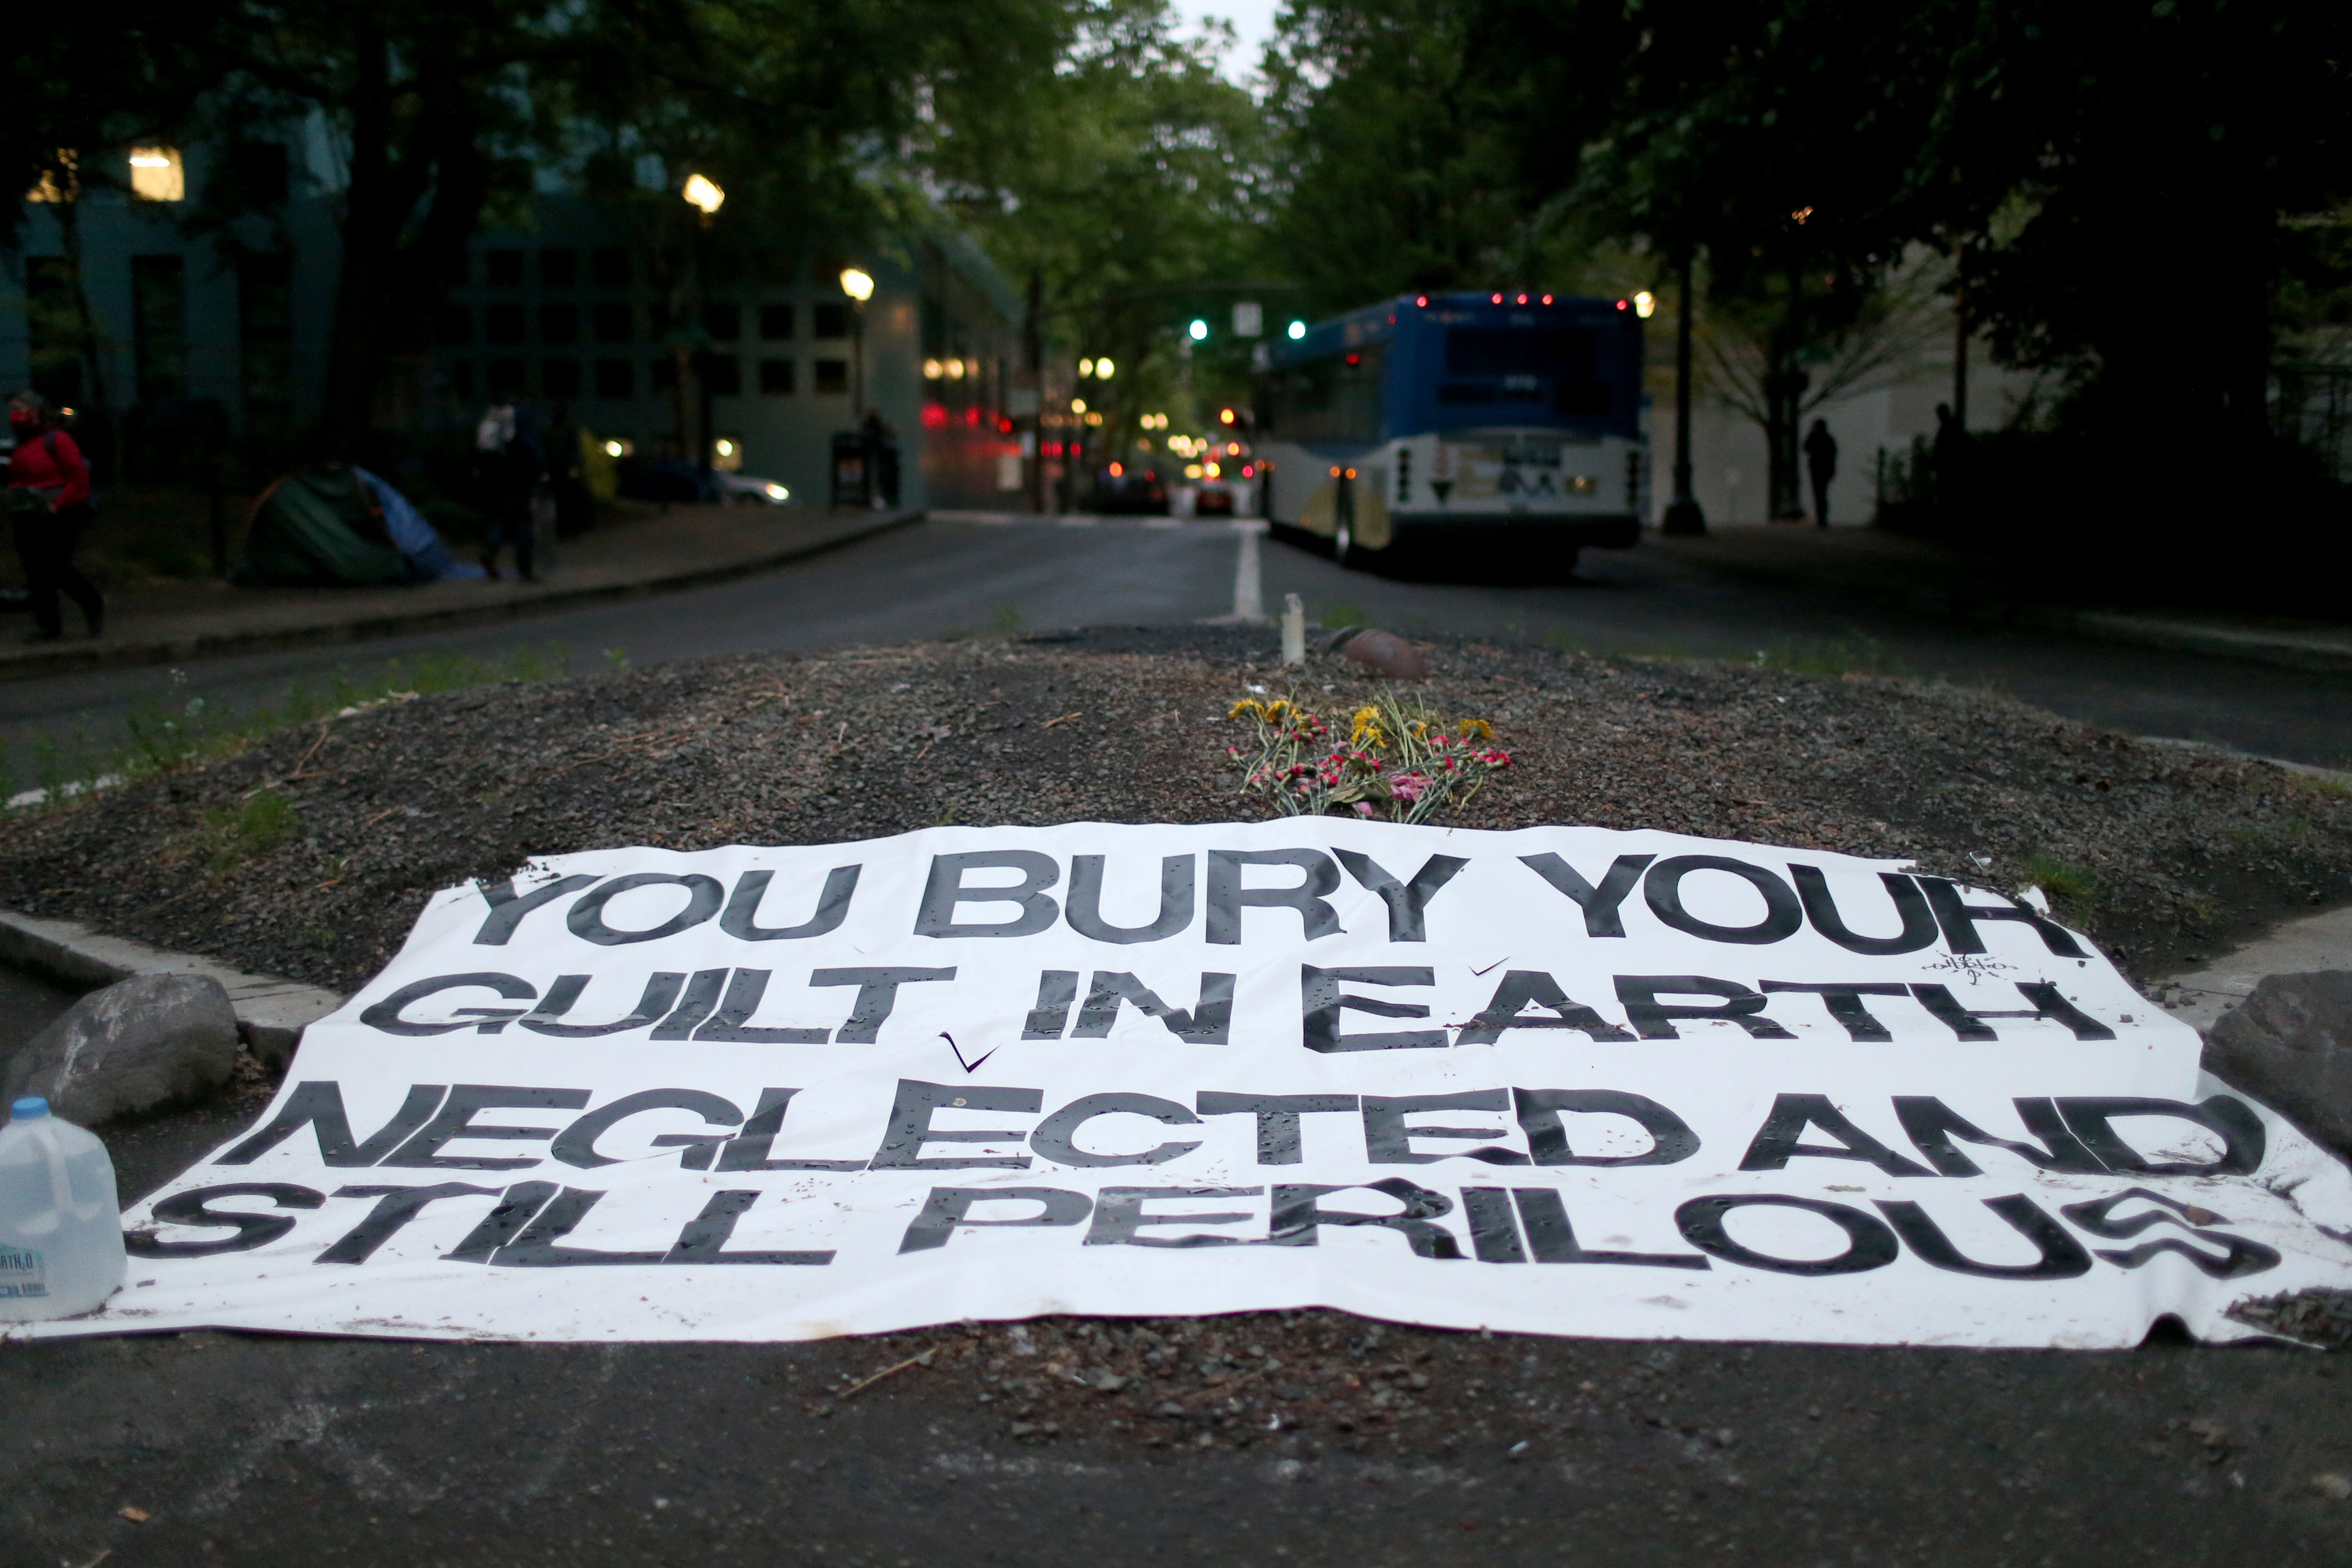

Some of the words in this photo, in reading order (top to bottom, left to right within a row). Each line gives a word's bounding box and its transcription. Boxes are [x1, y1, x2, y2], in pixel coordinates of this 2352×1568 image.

[472, 863, 863, 946] YOU
[913, 847, 1471, 945] BURY
[1516, 852, 2095, 958] YOUR
[361, 966, 958, 1045] GUILT
[1020, 969, 1237, 1045] IN
[1301, 962, 2117, 1054] EARTH
[214, 1079, 1701, 1172] NEGLECTED
[1737, 1092, 2267, 1179] AND
[125, 1179, 837, 1267] STILL
[896, 1176, 2283, 1281] PERILOUS
